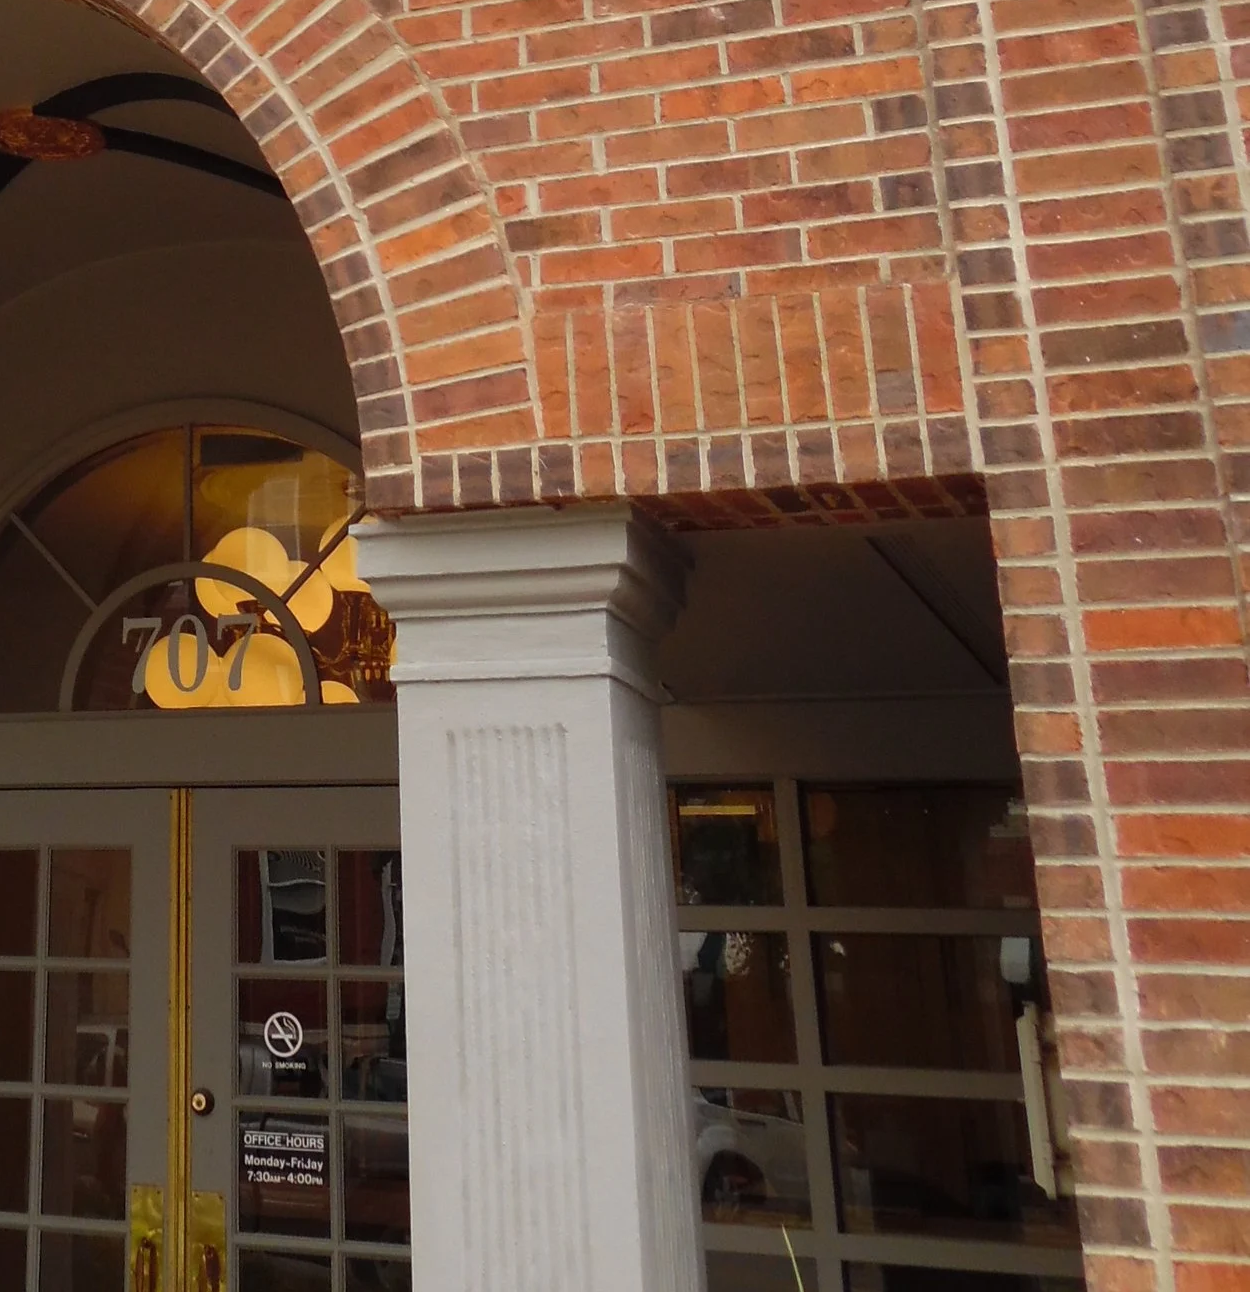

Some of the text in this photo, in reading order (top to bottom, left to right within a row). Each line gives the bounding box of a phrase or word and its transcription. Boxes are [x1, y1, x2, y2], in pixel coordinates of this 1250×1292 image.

[122, 613, 261, 695] 707
[262, 1061, 307, 1070] NO SMOKING
[243, 1133, 325, 1149] OFFICE HOURS
